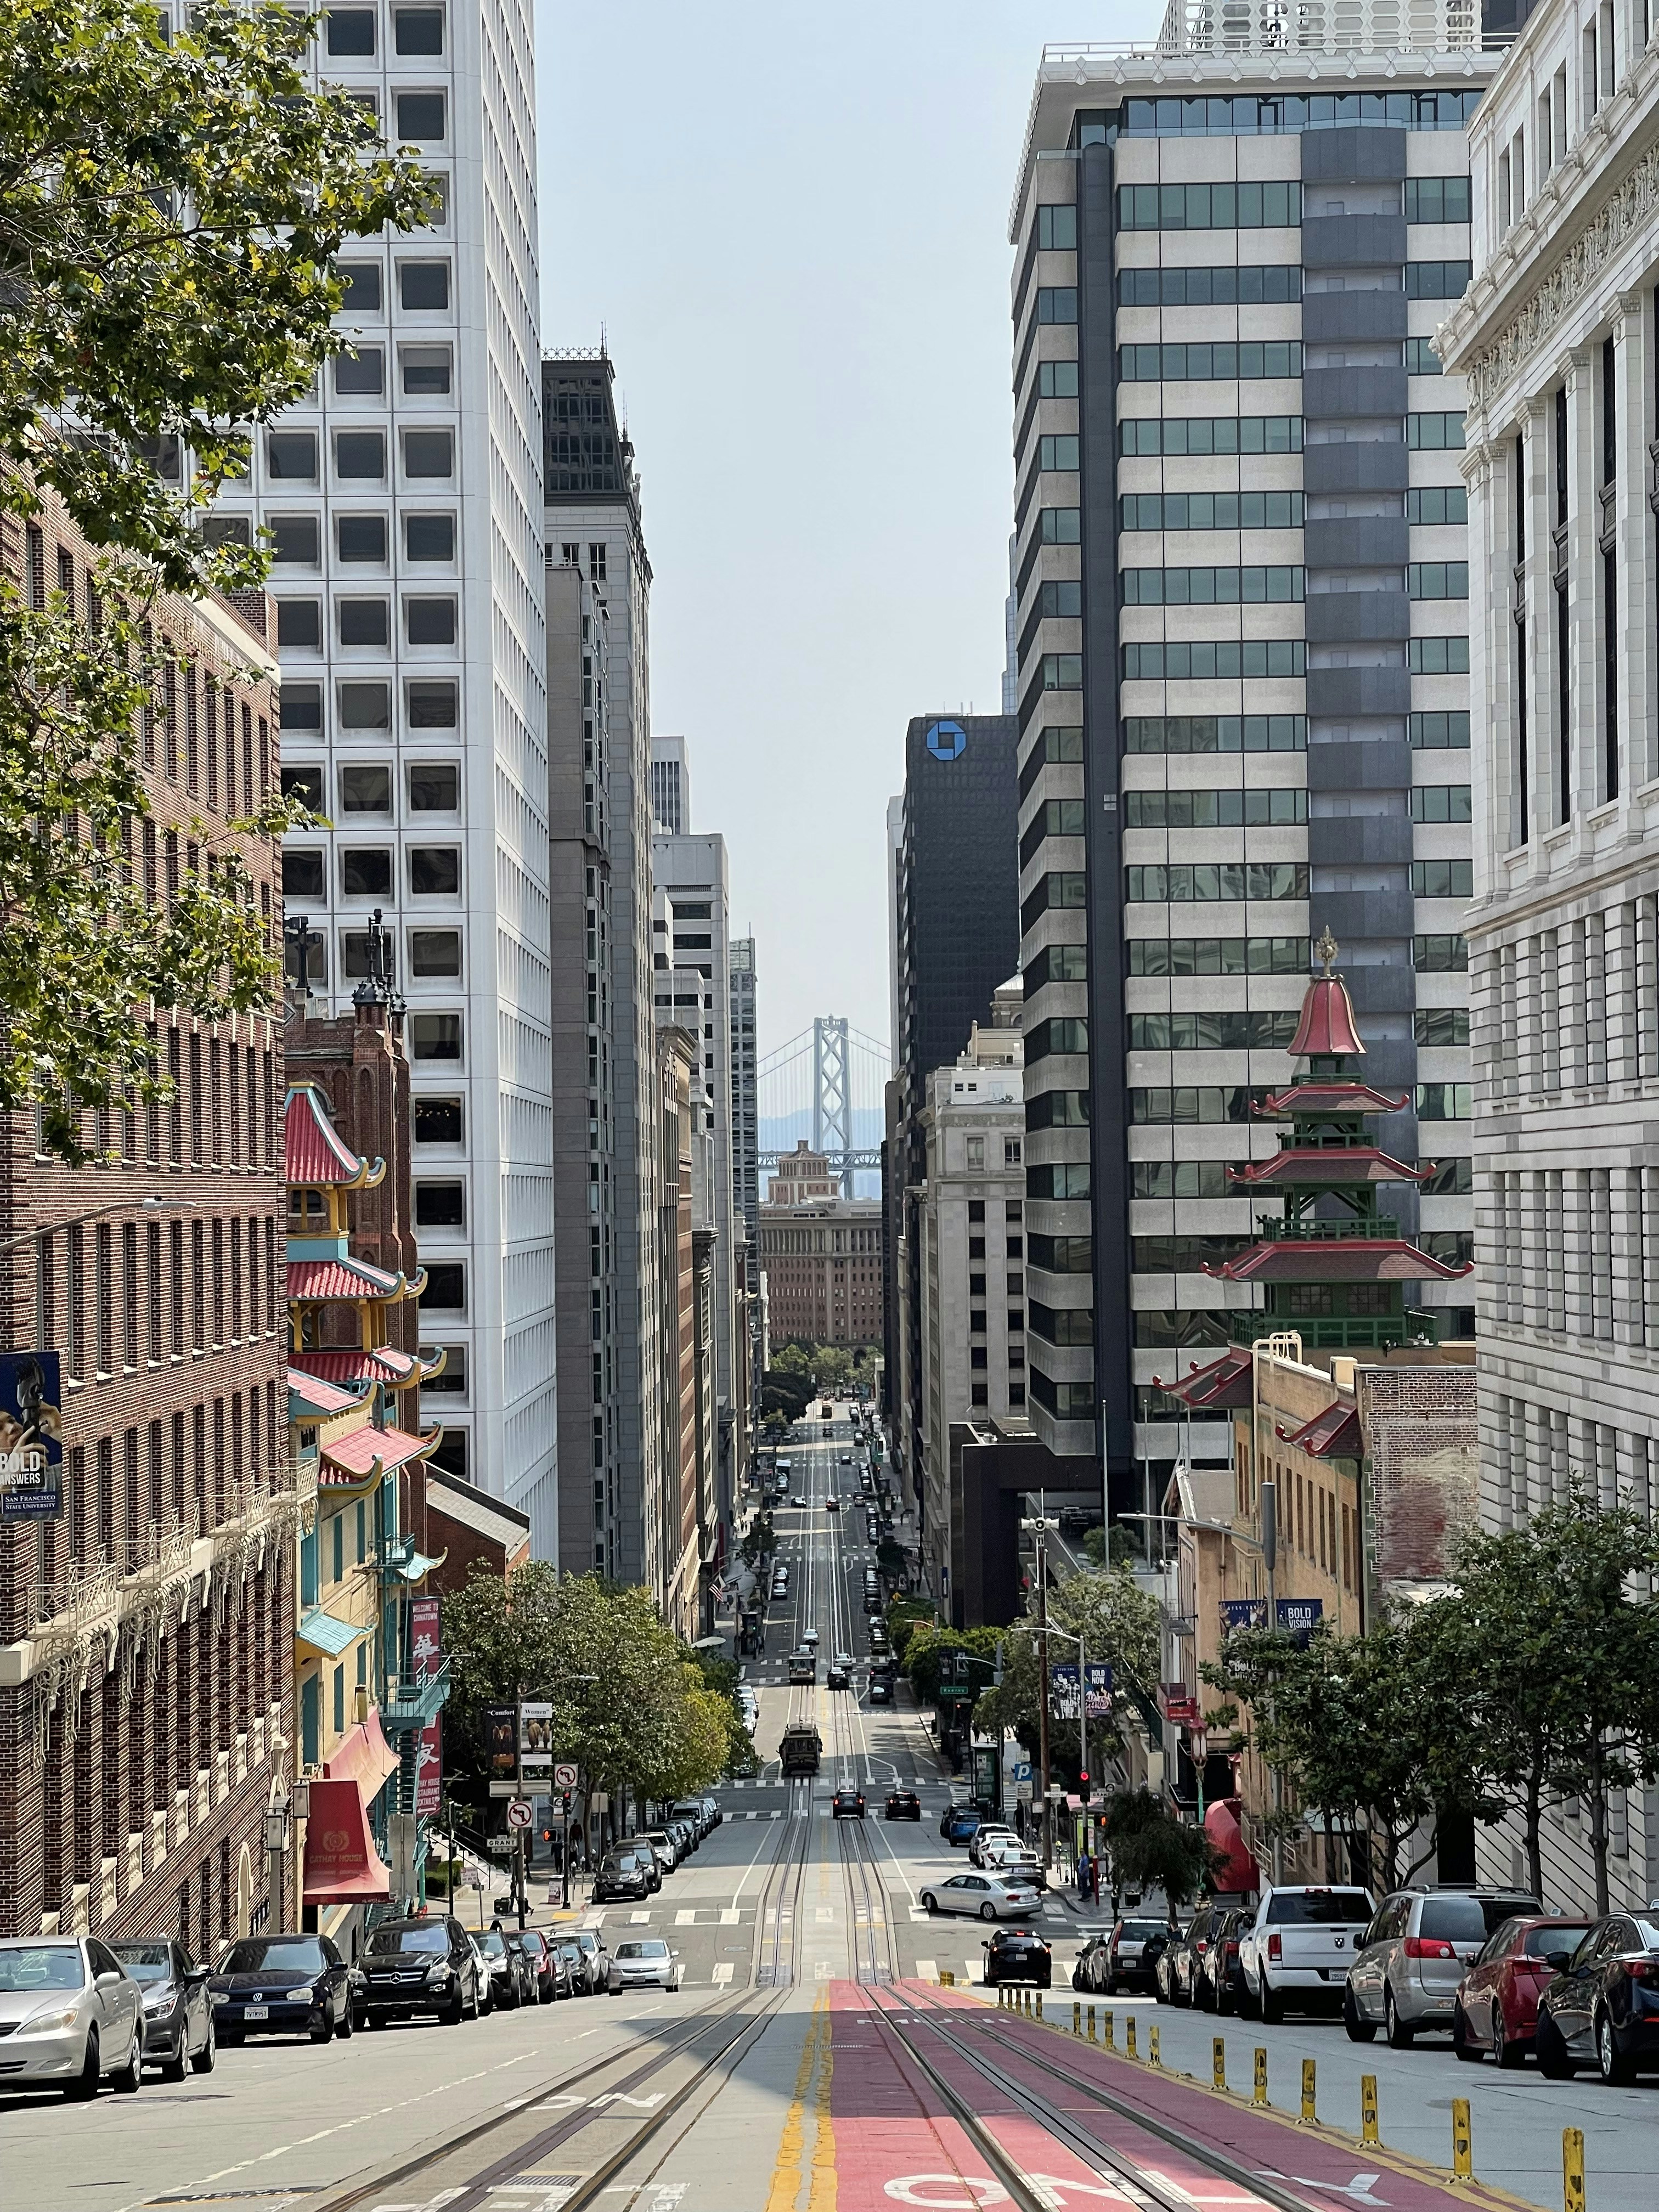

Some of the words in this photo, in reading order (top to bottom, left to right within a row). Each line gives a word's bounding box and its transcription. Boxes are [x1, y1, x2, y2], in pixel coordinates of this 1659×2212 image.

[0, 1452, 40, 1472] BOLD
[0, 1473, 41, 1485] ANSWERS
[413, 1604, 432, 1613] WELCOME
[433, 1603, 438, 1611] TO
[1288, 1607, 1311, 1619] BOLD
[413, 1612, 437, 1622] CHINATOWN
[1289, 1620, 1312, 1628] VISION
[309, 1855, 336, 1863] CATHAY
[338, 1854, 363, 1863] HOUSE
[883, 2169, 1393, 2211] ONLY
